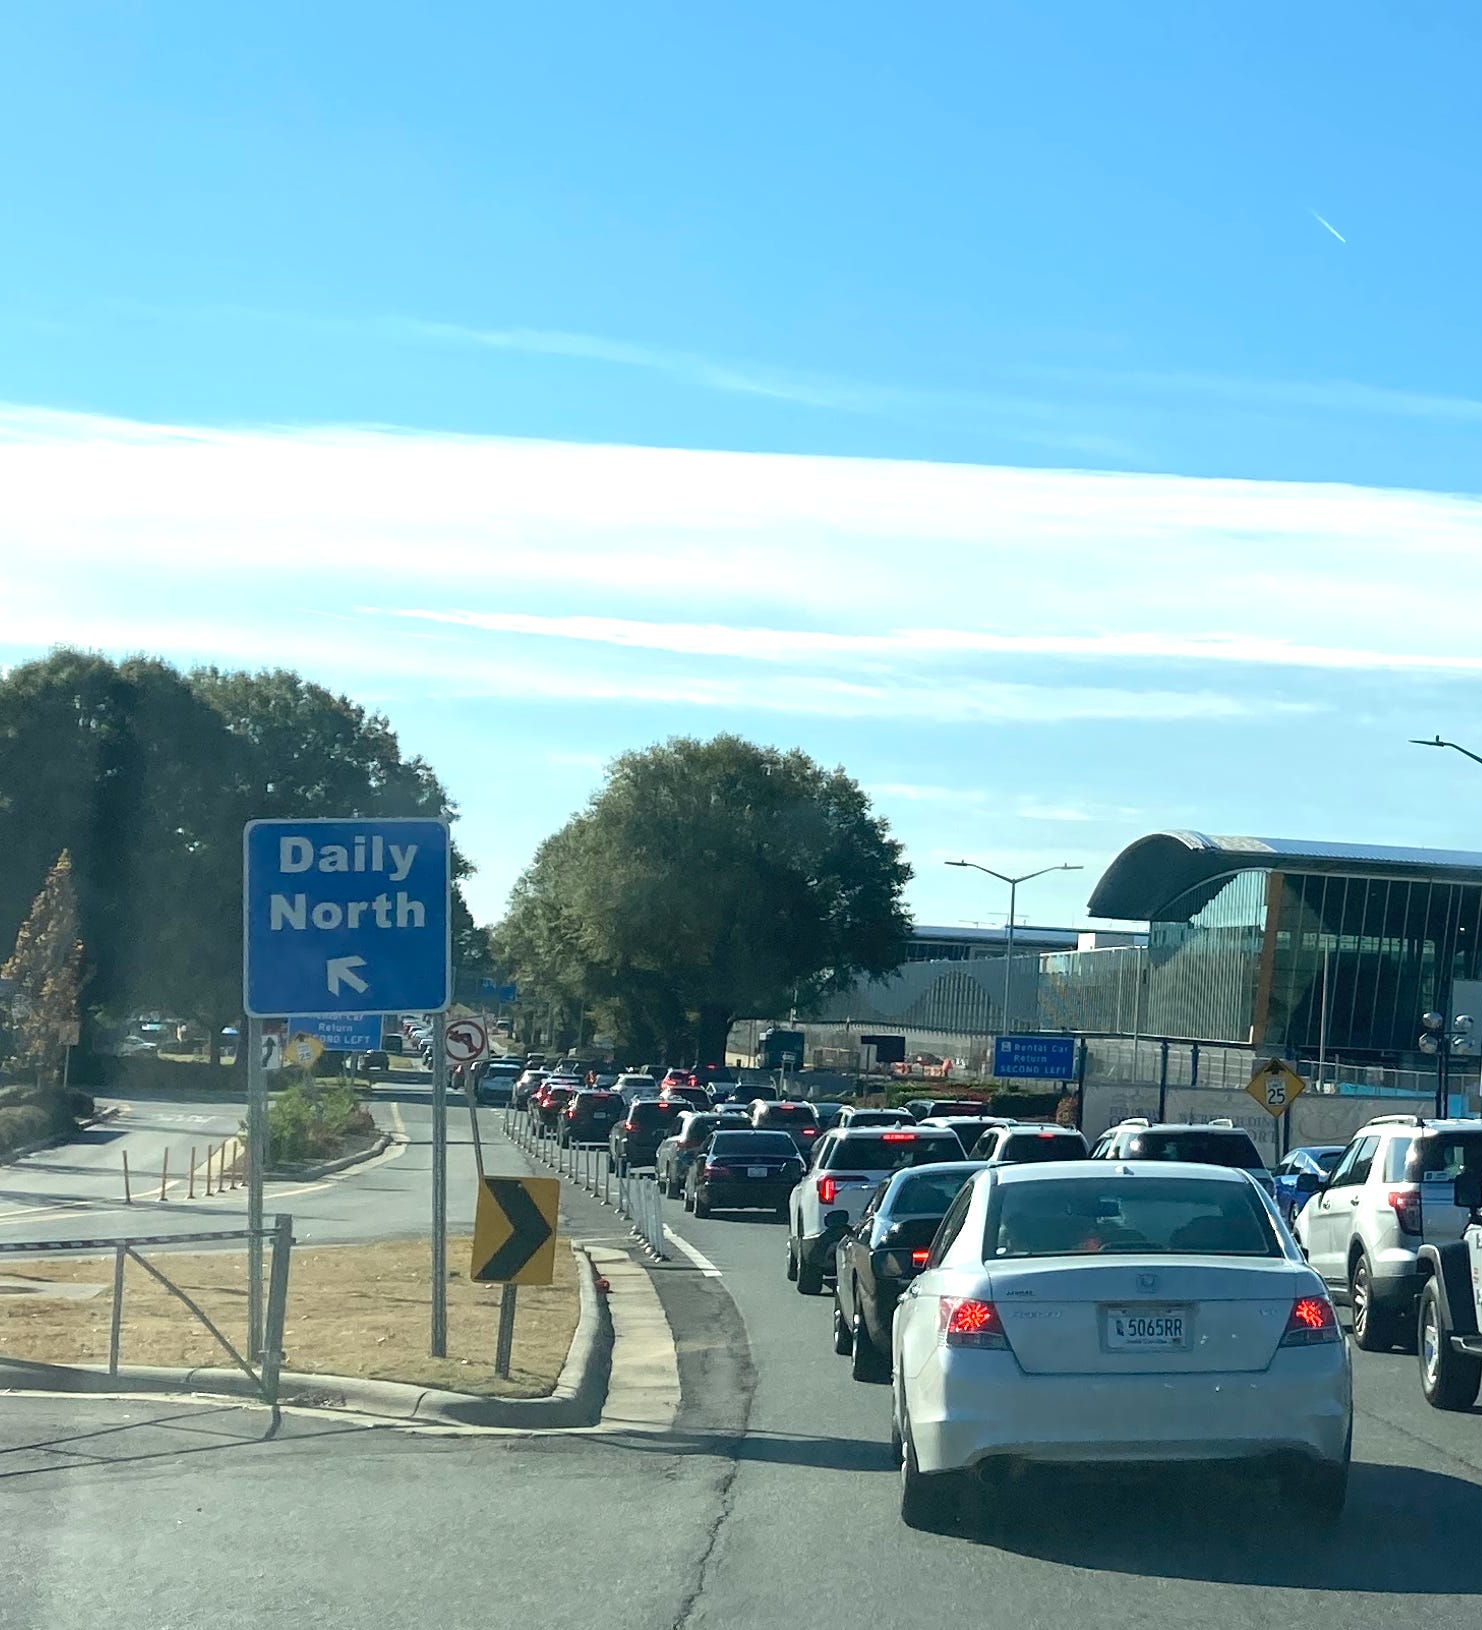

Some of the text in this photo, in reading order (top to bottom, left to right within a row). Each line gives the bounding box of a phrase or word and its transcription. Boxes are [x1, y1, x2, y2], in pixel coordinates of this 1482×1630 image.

[279, 835, 418, 881] Daily
[270, 891, 426, 931] North
[318, 1022, 353, 1033] Return
[344, 1035, 371, 1045] LEFT
[1014, 1043, 1069, 1053] Rental Car
[1013, 1054, 1048, 1063] Return
[1000, 1064, 1067, 1075] SECOND LEFT
[1267, 1087, 1286, 1105] 25
[1128, 1318, 1183, 1337] 5065RR
